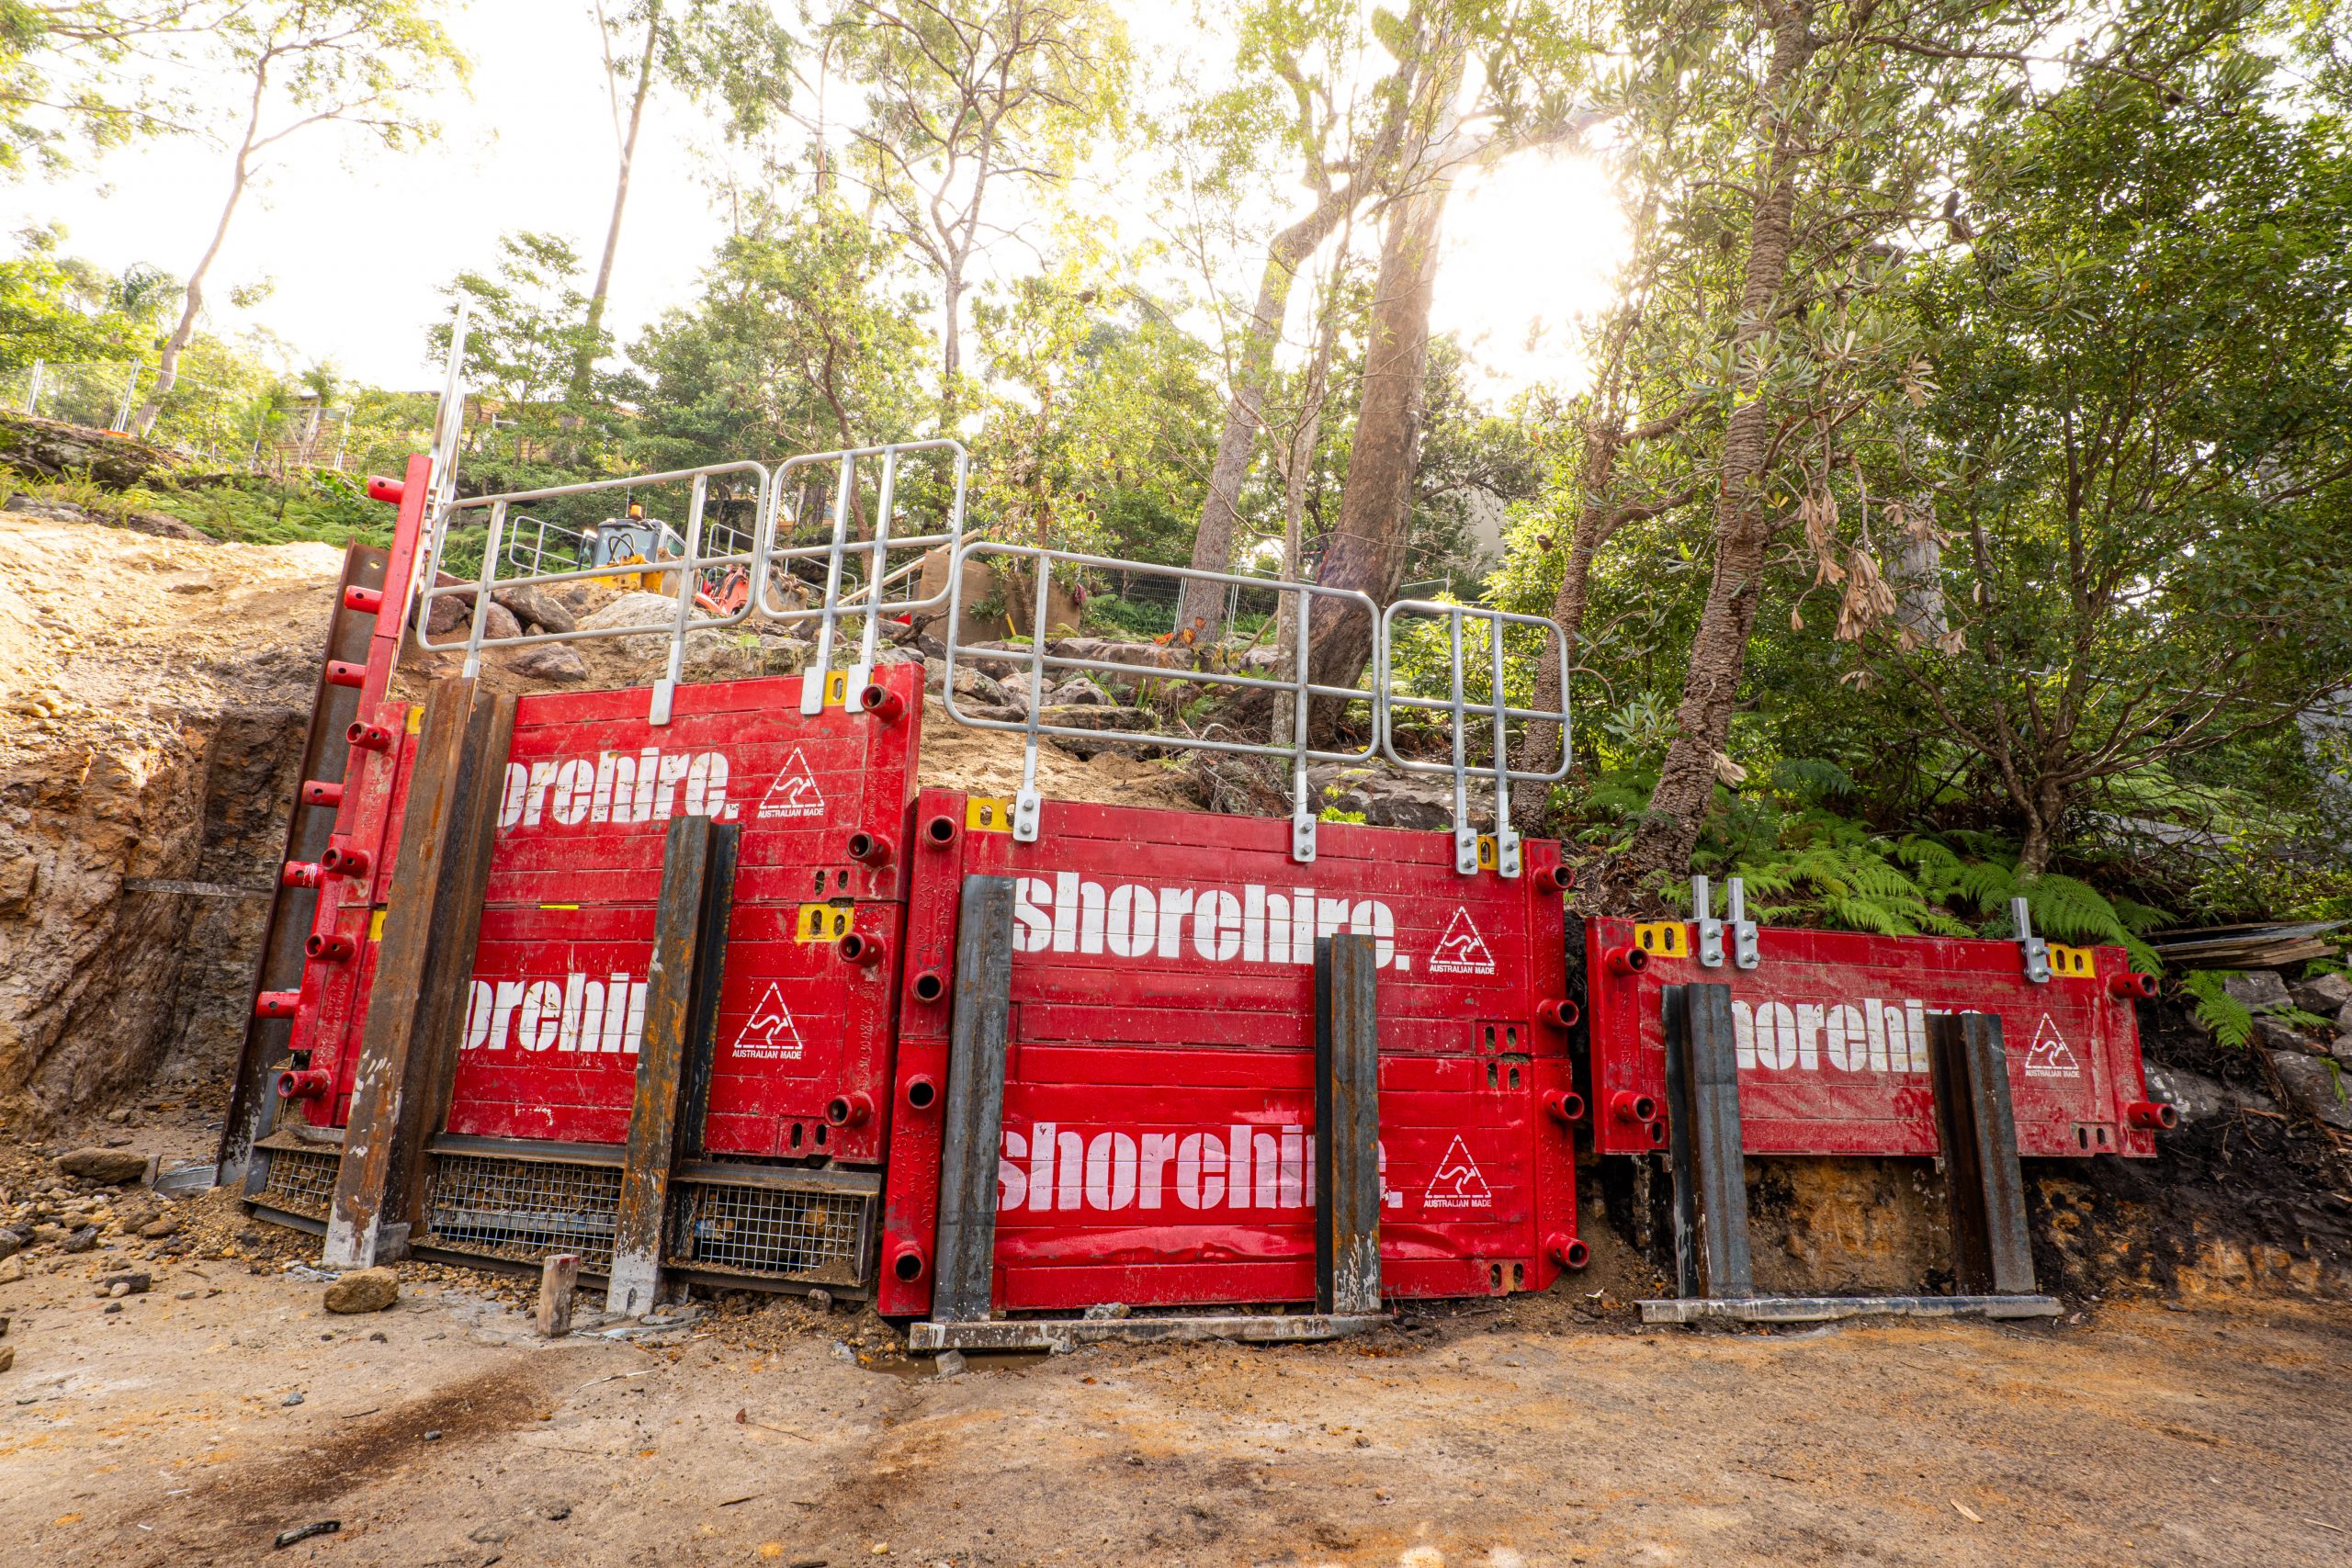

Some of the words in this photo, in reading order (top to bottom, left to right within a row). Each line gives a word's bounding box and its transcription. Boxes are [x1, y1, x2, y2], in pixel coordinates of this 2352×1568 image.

[497, 747, 739, 827] orehire.
[757, 809, 801, 818] AUSTRALIAN
[803, 808, 824, 817] MADE
[1012, 871, 1410, 970] shorehire.
[1430, 964, 1473, 974] AUSTRALIAN
[1475, 966, 1495, 975] MADE
[732, 1049, 777, 1059] AUSTRALIAN
[780, 1050, 801, 1060] MADE
[2025, 1069, 2062, 1077] AUSTRALIAN
[2063, 1070, 2080, 1078] MADE
[996, 1122, 1402, 1211] shorehi.
[1423, 1199, 1469, 1208] AUSTRALIAN
[1471, 1199, 1492, 1208] MADE
